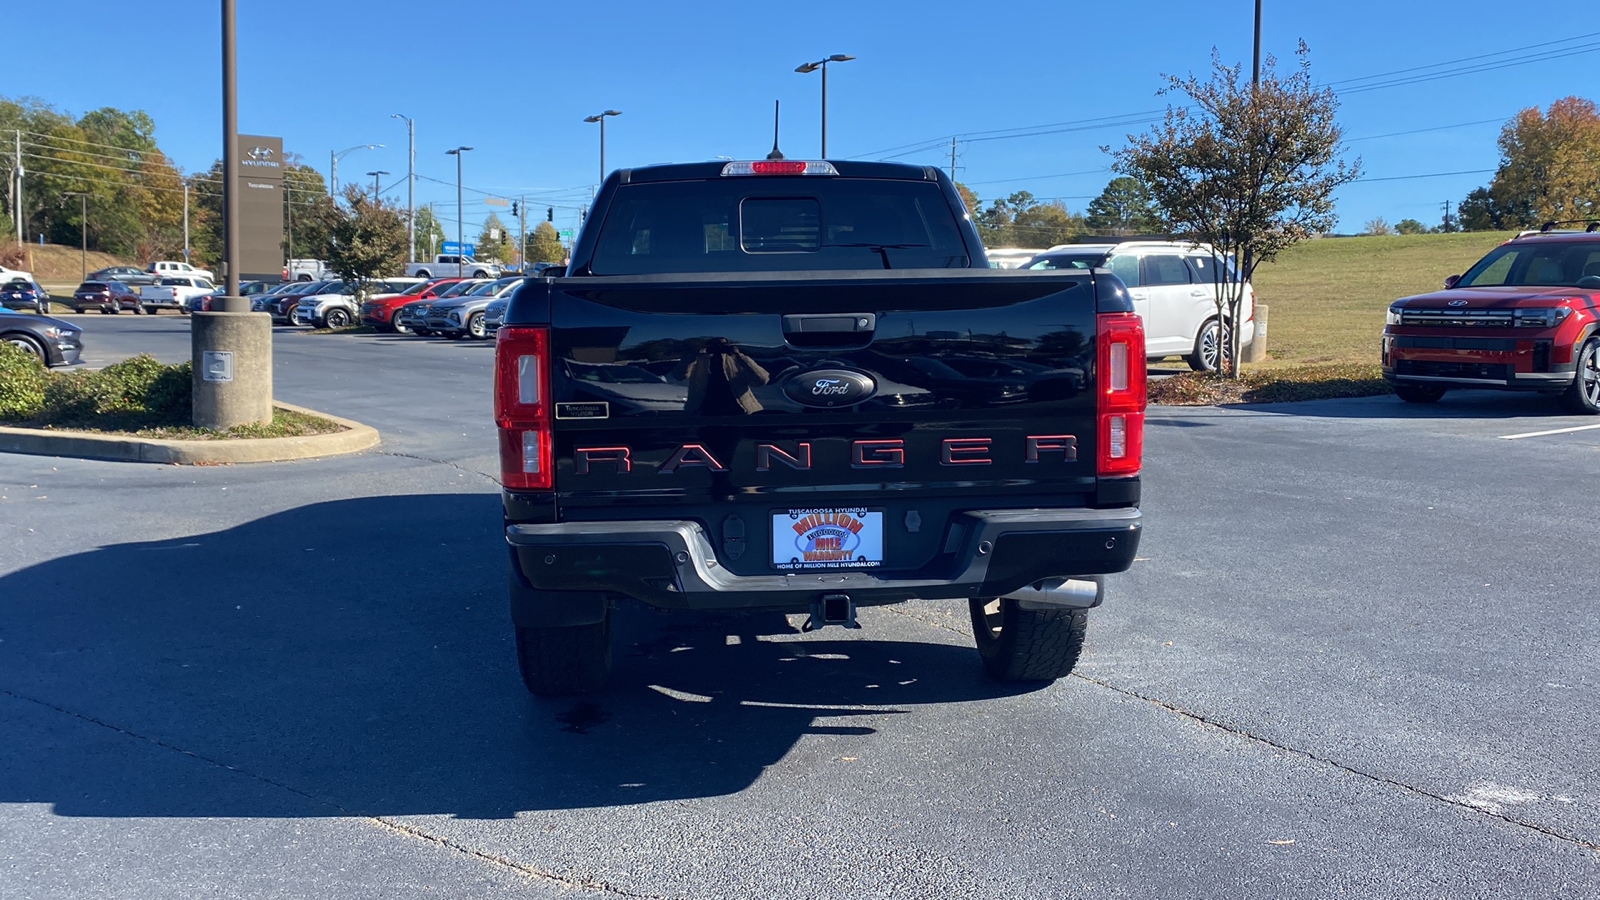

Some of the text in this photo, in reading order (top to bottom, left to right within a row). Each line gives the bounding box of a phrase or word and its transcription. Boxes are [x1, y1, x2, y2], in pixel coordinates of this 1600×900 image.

[812, 379, 849, 395] Ford
[575, 434, 1078, 474] RANGER
[792, 513, 864, 536] MILLION
[815, 538, 842, 550] MILE
[803, 550, 853, 561] WARRANTY
